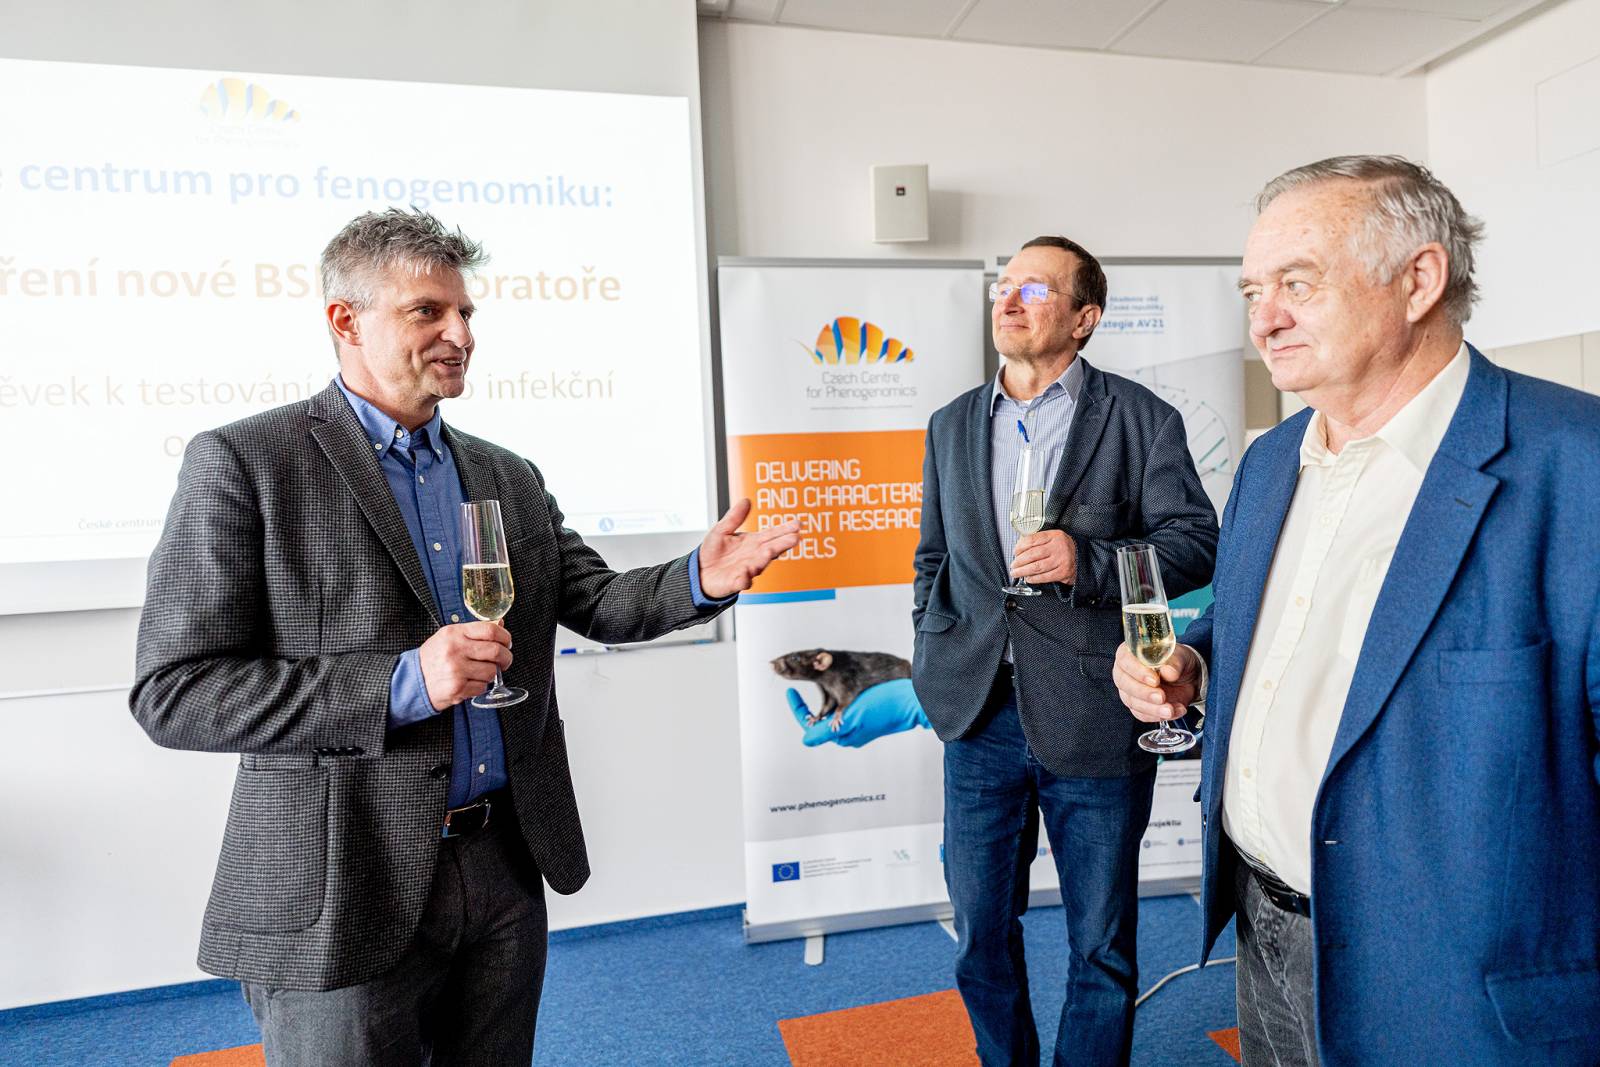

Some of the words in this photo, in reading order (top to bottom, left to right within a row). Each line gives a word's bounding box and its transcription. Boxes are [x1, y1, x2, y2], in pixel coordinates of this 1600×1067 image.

[19, 162, 213, 195] centrum
[229, 171, 300, 204] pro
[313, 165, 613, 208] fenogenomiku:
[117, 259, 237, 298] nové
[465, 265, 621, 301] oratoře
[1137, 318, 1164, 329] AV21
[105, 375, 126, 406] k
[137, 372, 313, 407] testování
[487, 369, 615, 400] infekční
[822, 371, 858, 385] Czech
[861, 371, 900, 384] Centre
[806, 386, 822, 399] for
[826, 384, 918, 401] Phenogenomics
[755, 459, 861, 484] DELIVERING
[756, 487, 799, 510] AND
[803, 482, 924, 508] CHARACTERIS
[838, 507, 922, 532] RESEARC
[769, 794, 886, 812] www.phenogenomics.cz
